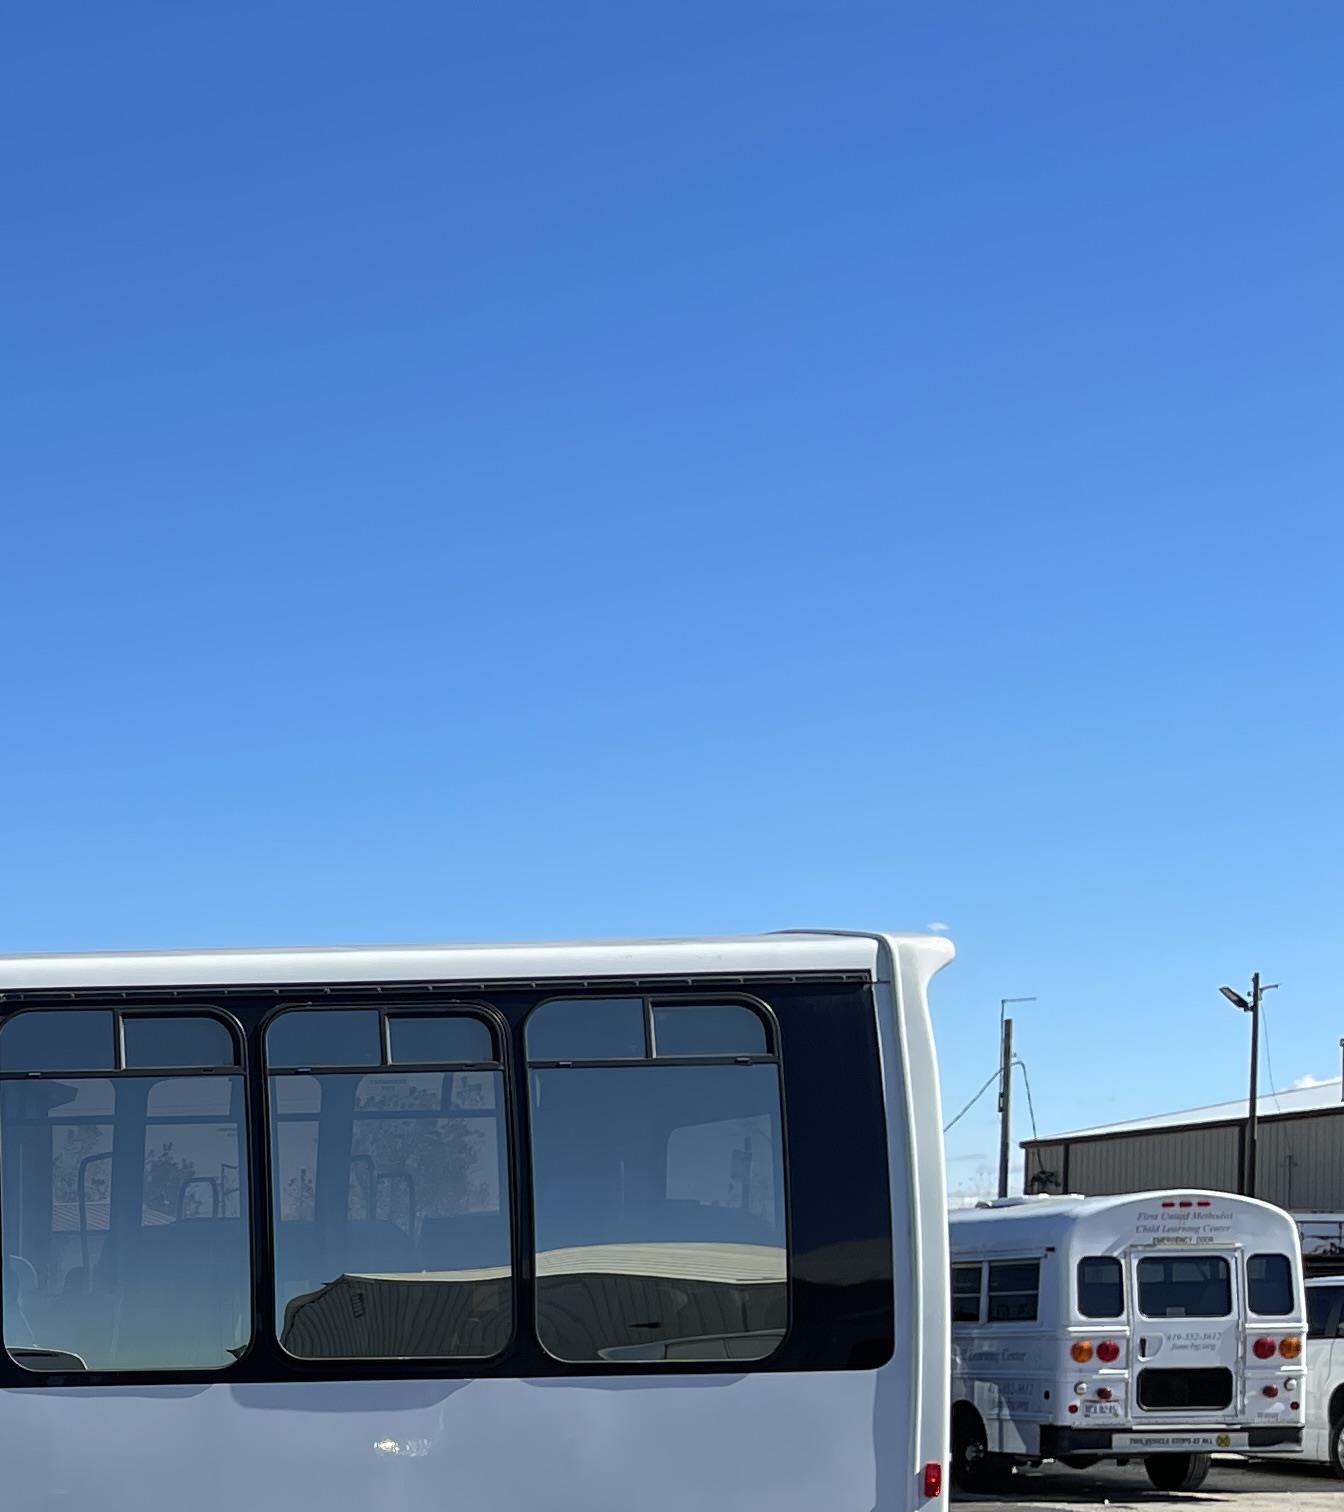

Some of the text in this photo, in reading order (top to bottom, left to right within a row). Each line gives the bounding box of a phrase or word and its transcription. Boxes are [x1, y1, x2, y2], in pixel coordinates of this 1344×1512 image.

[1161, 1211, 1190, 1221] United
[1192, 1210, 1233, 1221] Methodist
[1136, 1224, 1231, 1234] Child Learning Center
